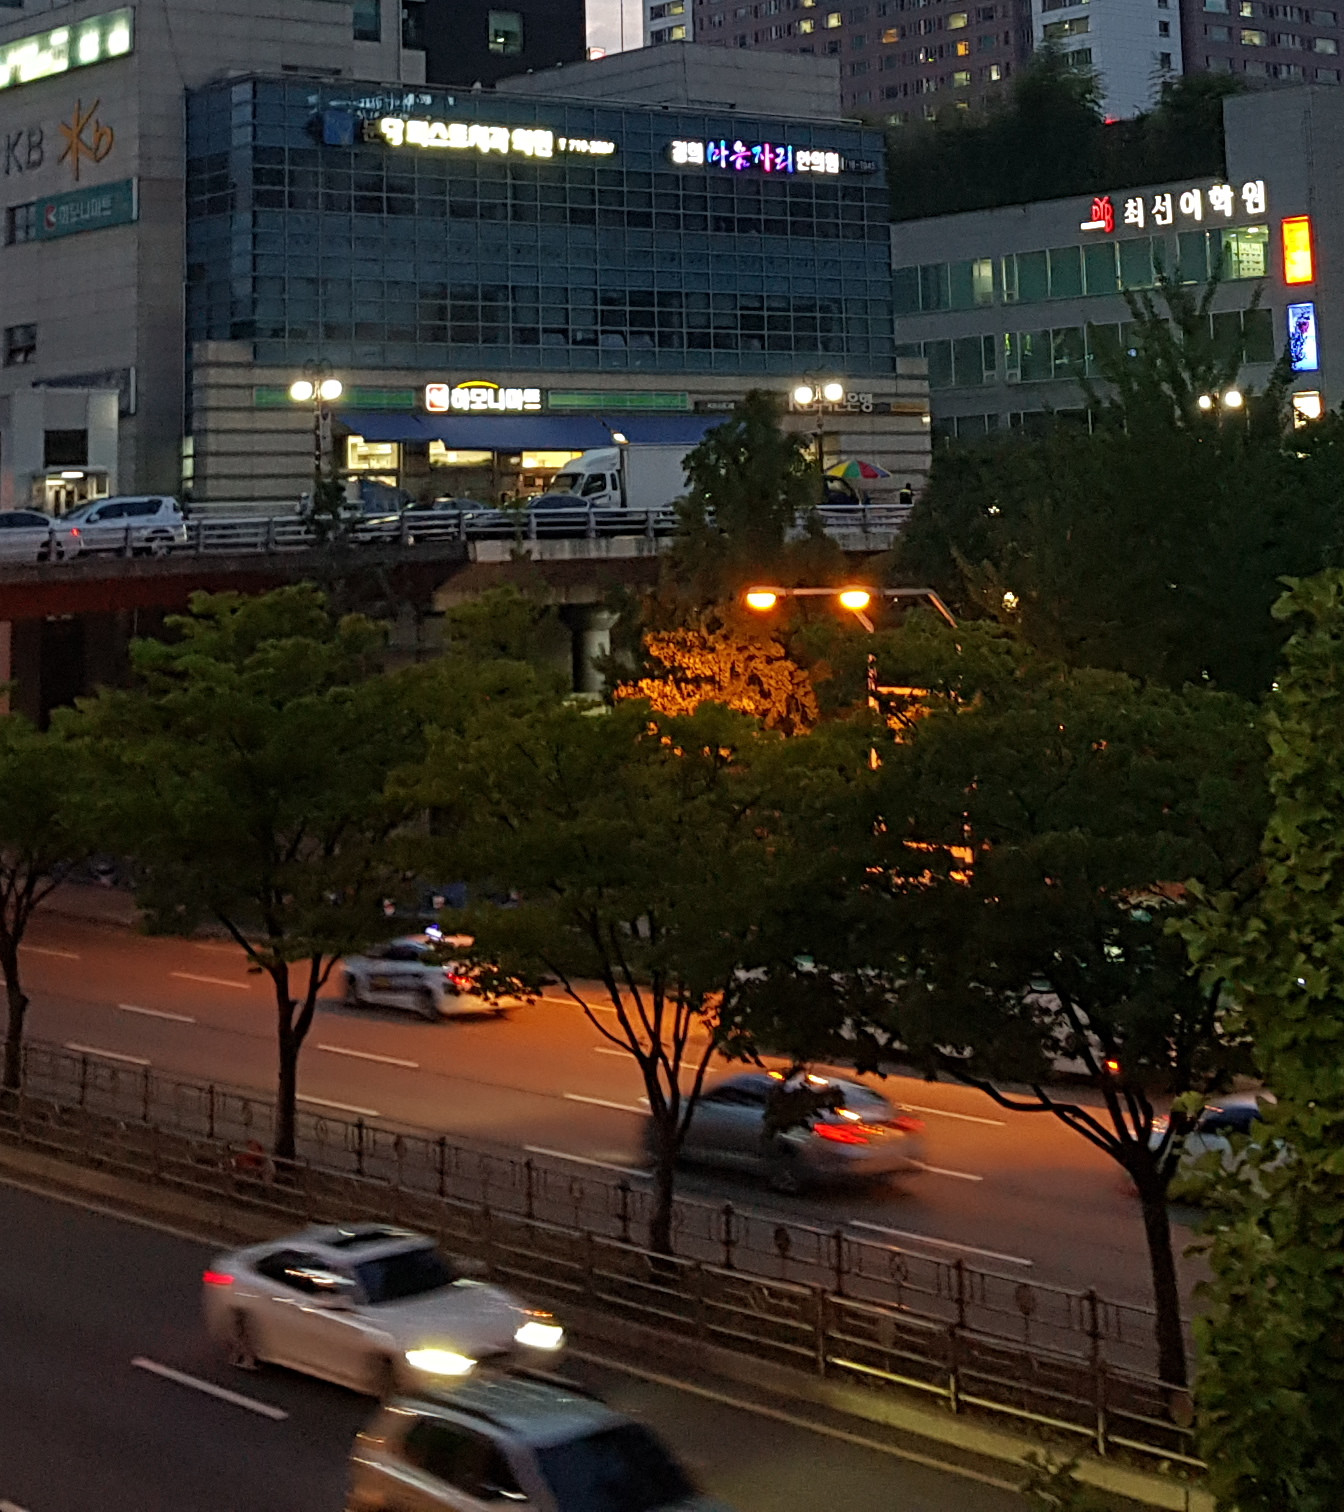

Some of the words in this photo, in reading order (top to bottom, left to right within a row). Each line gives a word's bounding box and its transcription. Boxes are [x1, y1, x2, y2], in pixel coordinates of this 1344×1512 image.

[5, 127, 44, 175] KB
[1123, 180, 1266, 228] 최선어학원
[451, 387, 542, 411] 하모니마트
